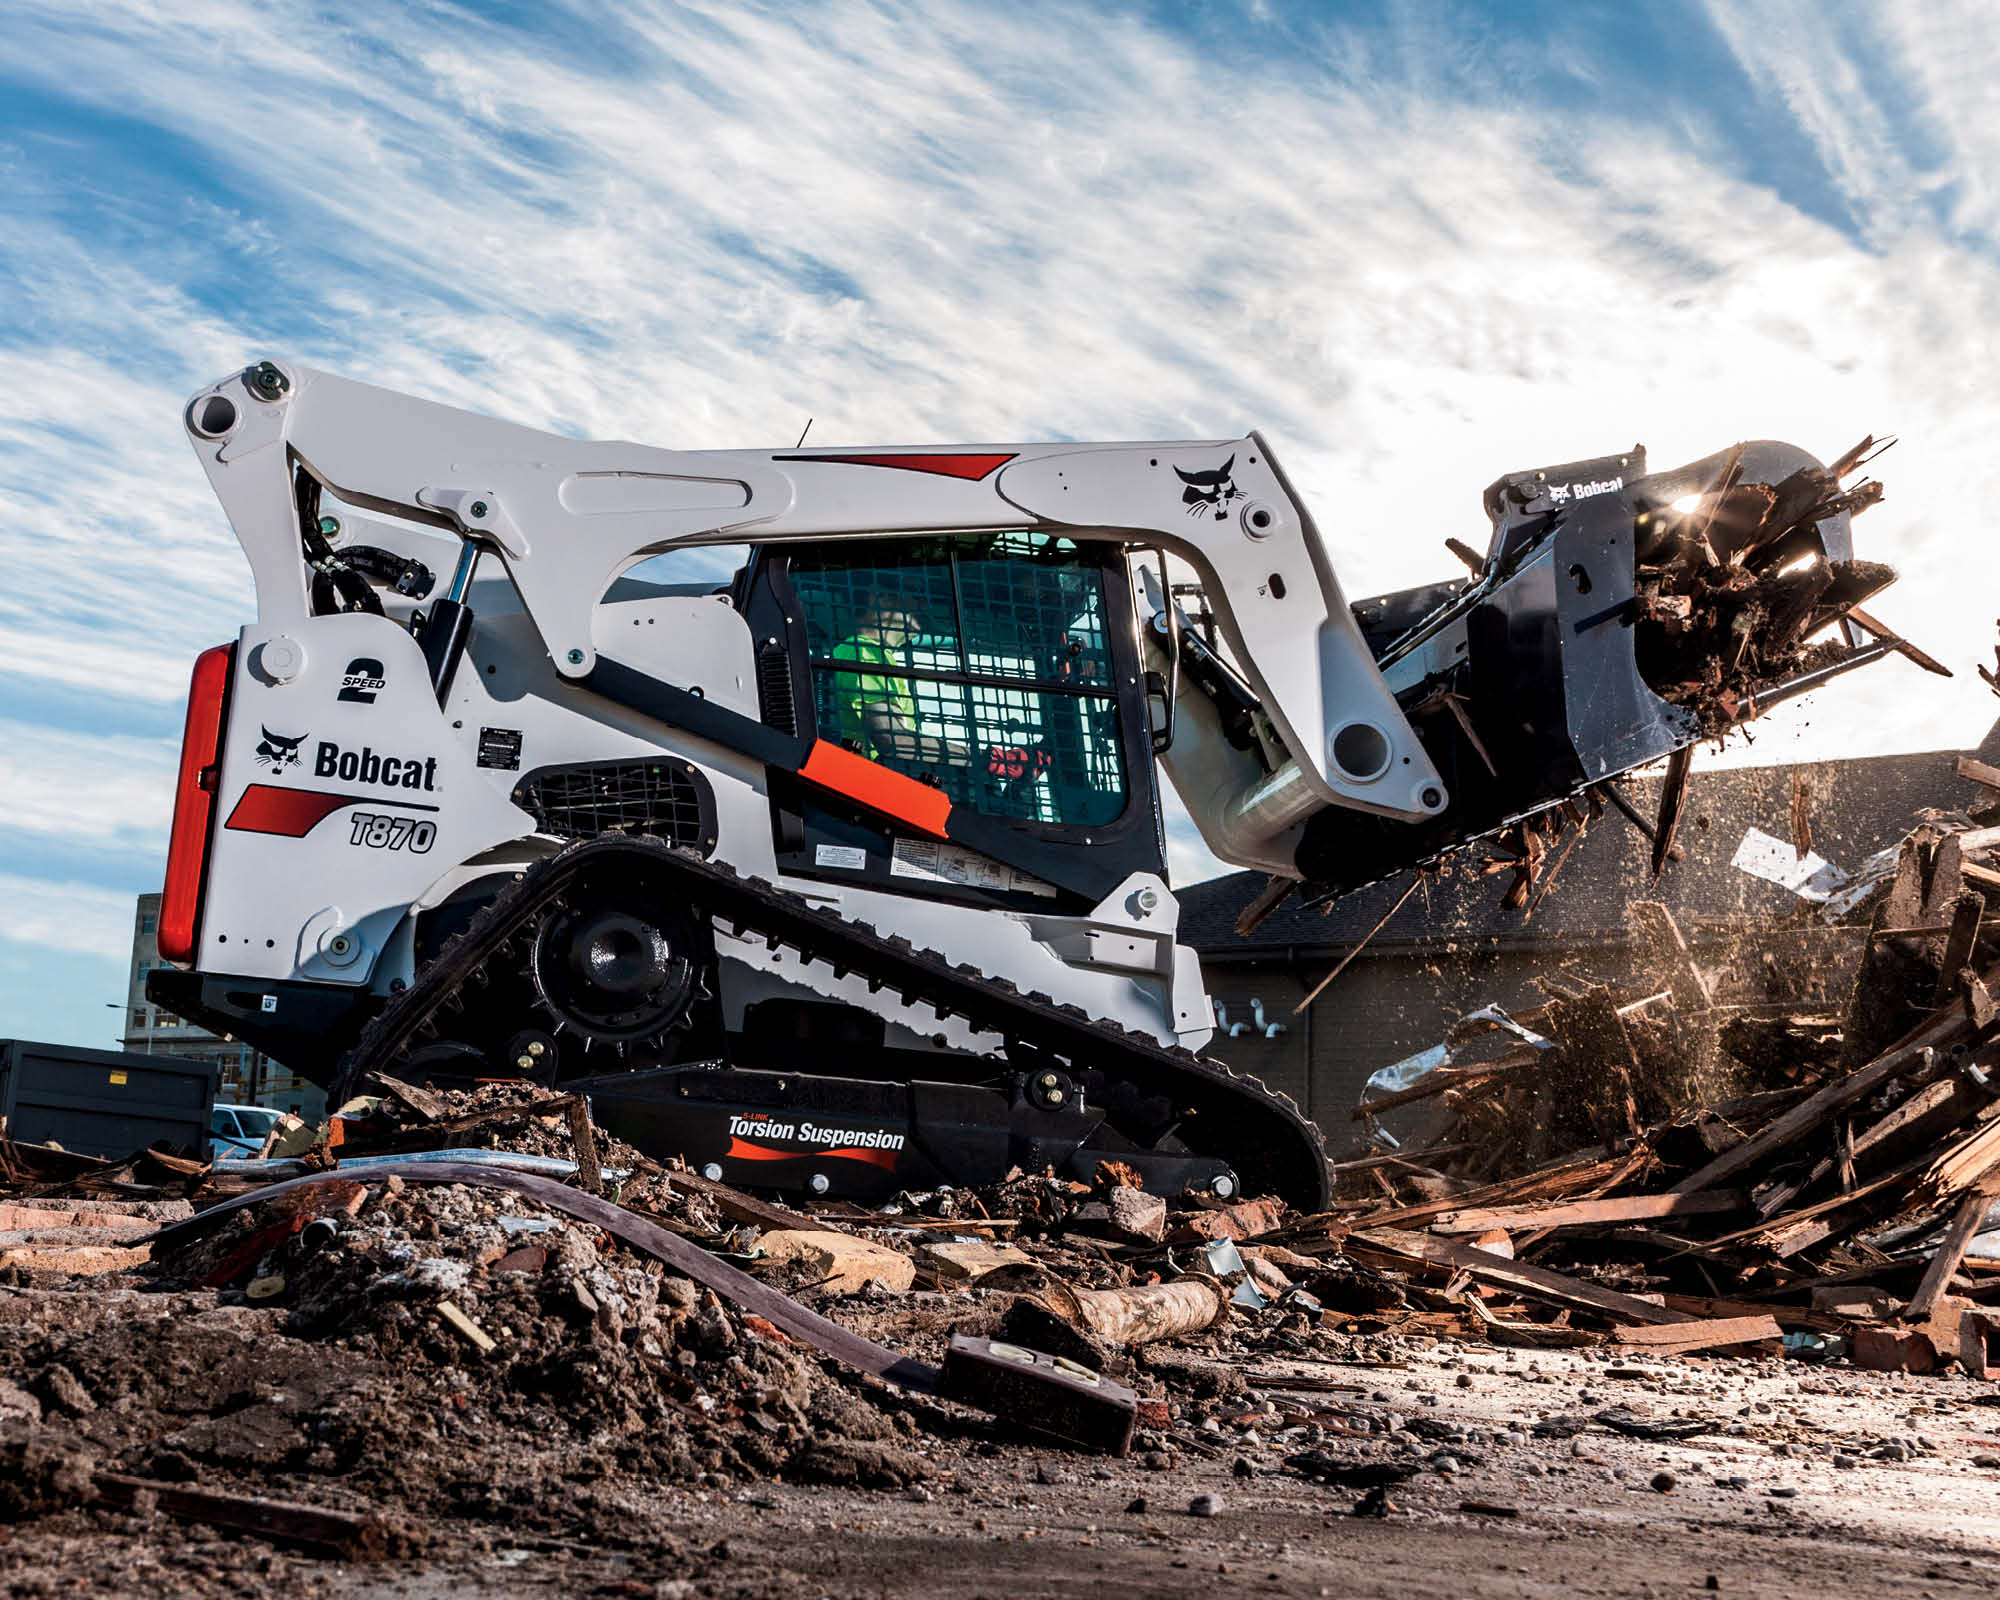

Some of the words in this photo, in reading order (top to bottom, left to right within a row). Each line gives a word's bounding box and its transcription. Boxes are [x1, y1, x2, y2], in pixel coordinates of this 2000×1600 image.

[1572, 476, 1623, 500] Bobcat
[337, 657, 385, 704] 2
[342, 676, 386, 689] SPEED
[314, 741, 438, 792] Bobcat
[350, 811, 438, 854] T870
[729, 1115, 795, 1140] Torsion
[798, 1122, 905, 1150] Suspension
[742, 1112, 769, 1121] 5-LINK
